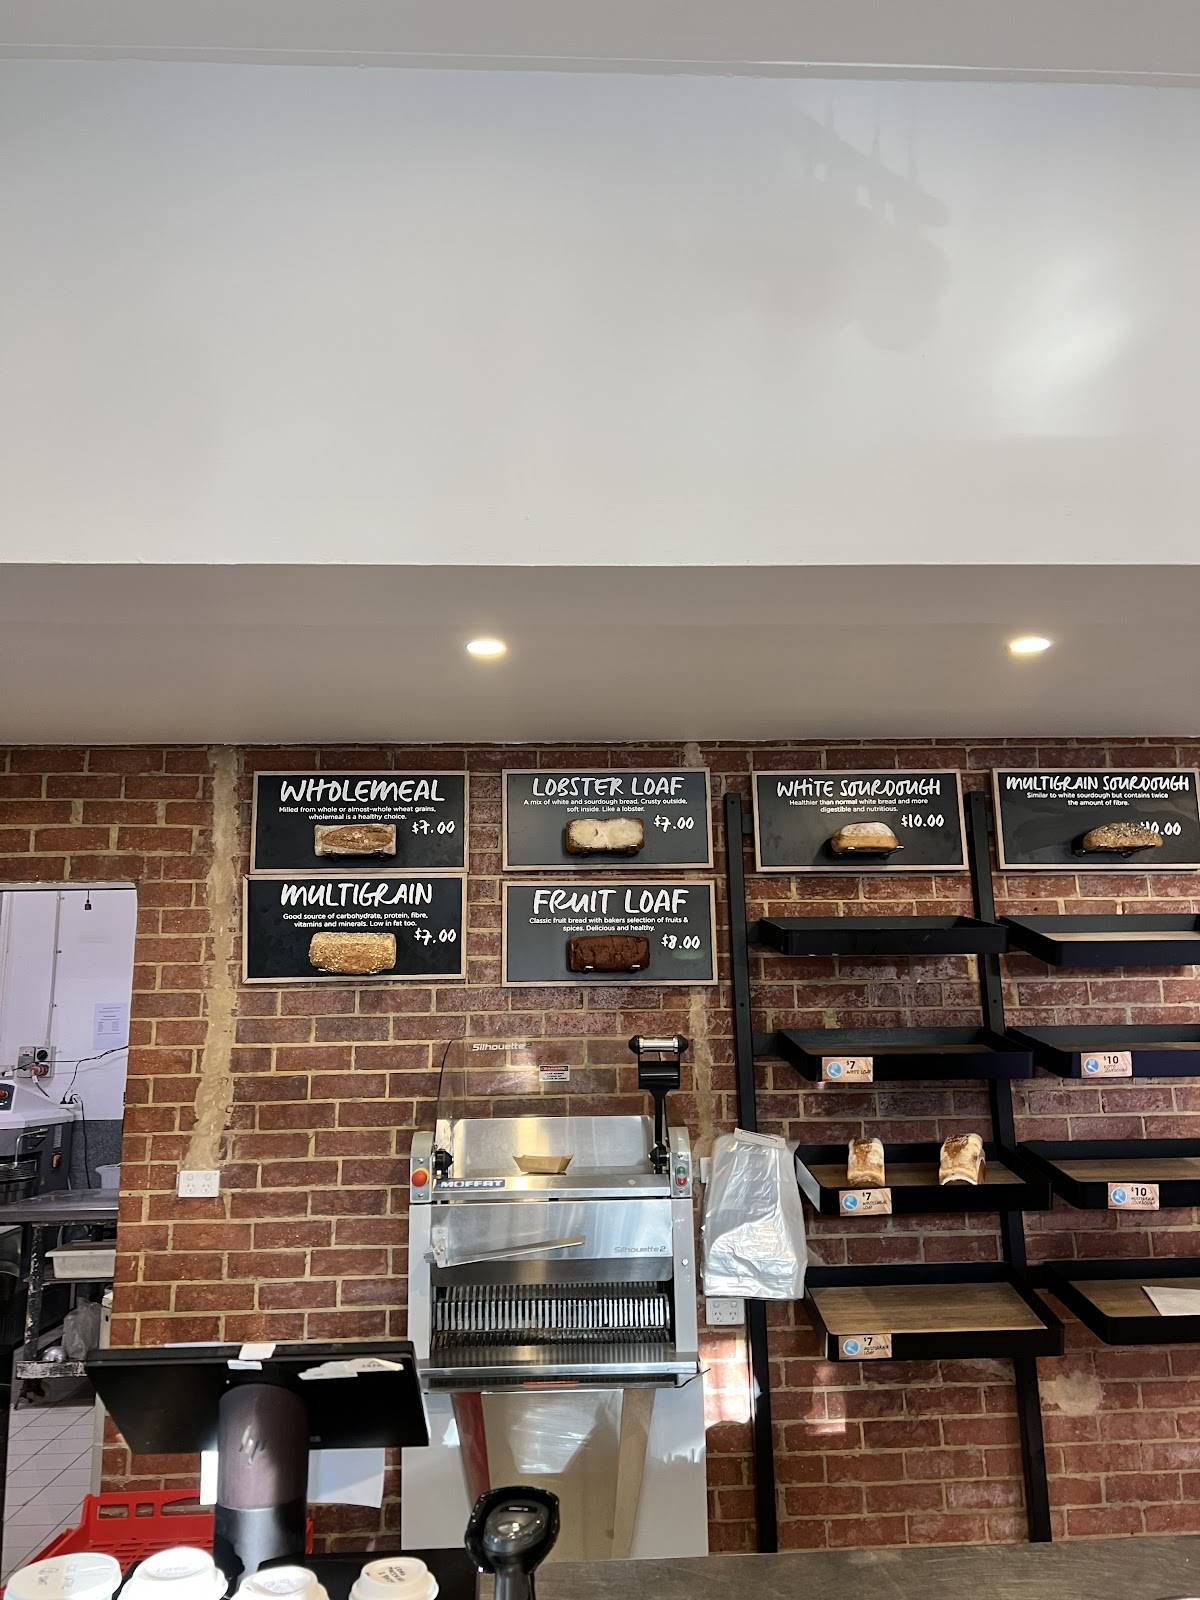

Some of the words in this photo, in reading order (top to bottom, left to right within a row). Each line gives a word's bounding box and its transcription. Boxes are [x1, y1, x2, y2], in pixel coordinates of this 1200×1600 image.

[280, 779, 445, 802] WHOLEMEAL
[532, 777, 624, 796] LOBSTER
[631, 777, 685, 796] LOAF
[840, 778, 941, 797] SOURDOUGH
[1006, 776, 1098, 791] MULTIGRAIN
[1103, 776, 1190, 791] SOURDOUGH
[821, 806, 851, 814] digestible
[412, 820, 455, 835] $7.00
[654, 814, 695, 832] $7.00
[901, 814, 945, 828] $10.00
[280, 882, 432, 907] MULTIGRAIN
[533, 889, 617, 914] FRUIT
[625, 889, 689, 914] LOAF
[630, 924, 655, 932] healthy.
[414, 928, 456, 946] $7.00
[661, 934, 701, 950] $8.00
[847, 1061, 855, 1069] $7
[1104, 1056, 1118, 1064] $10
[863, 1192, 871, 1200] $7
[1131, 1187, 1147, 1196] $10
[864, 1337, 872, 1346] $7
